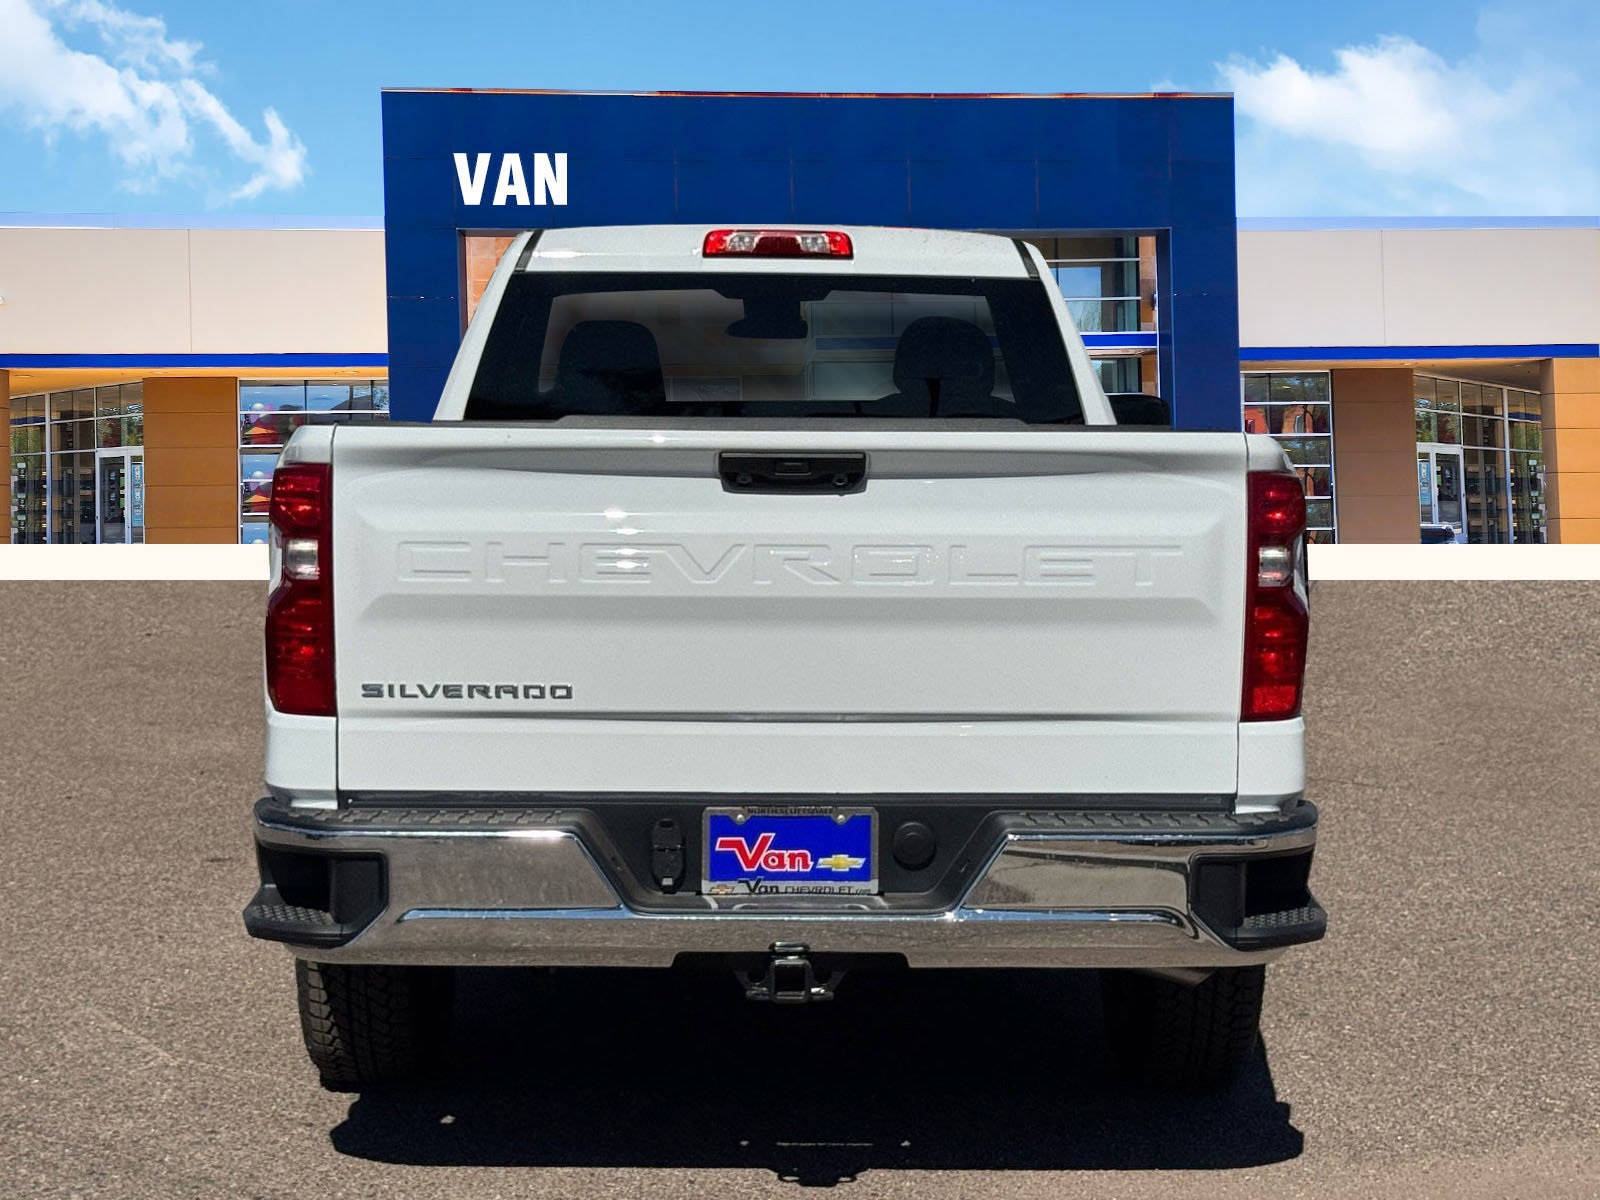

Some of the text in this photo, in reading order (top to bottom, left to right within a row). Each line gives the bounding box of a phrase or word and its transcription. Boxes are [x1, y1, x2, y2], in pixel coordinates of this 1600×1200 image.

[453, 153, 567, 205] VAN
[398, 541, 1183, 586] CHEVROLET
[361, 683, 573, 699] SILVERADO
[715, 833, 814, 872] Van
[738, 877, 779, 894] Van
